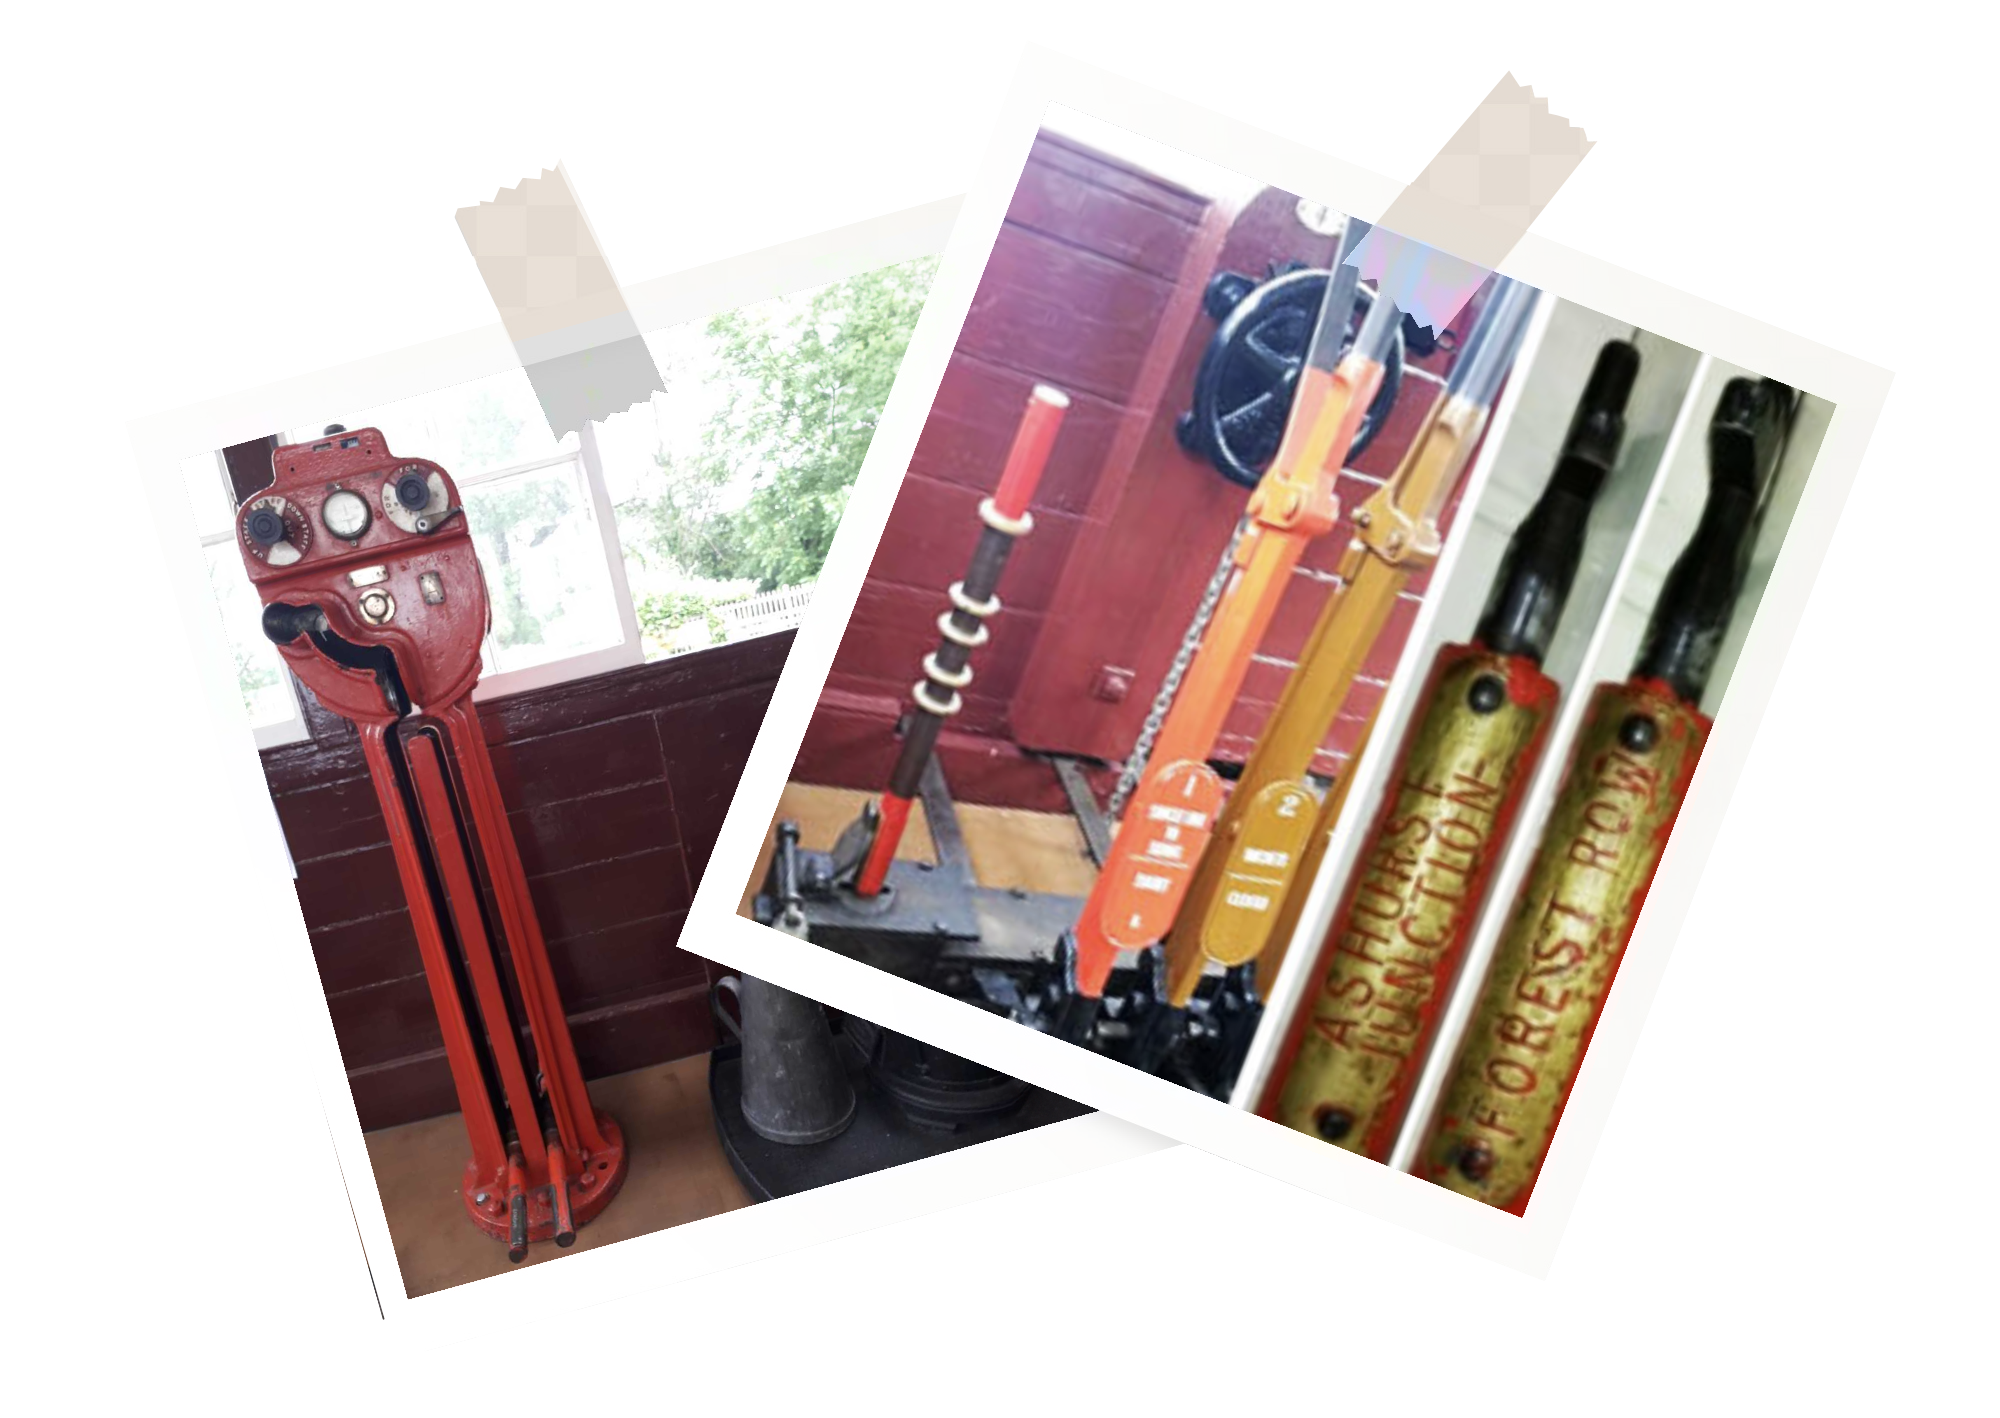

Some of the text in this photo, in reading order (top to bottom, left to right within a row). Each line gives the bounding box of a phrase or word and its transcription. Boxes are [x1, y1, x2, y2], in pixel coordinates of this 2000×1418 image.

[284, 520, 295, 538] OUT
[286, 502, 310, 550] DOWN STAFF
[1277, 794, 1300, 818] 2
[1313, 772, 1444, 1052] ASHURST
[1473, 750, 1657, 1138] FOREST ROW
